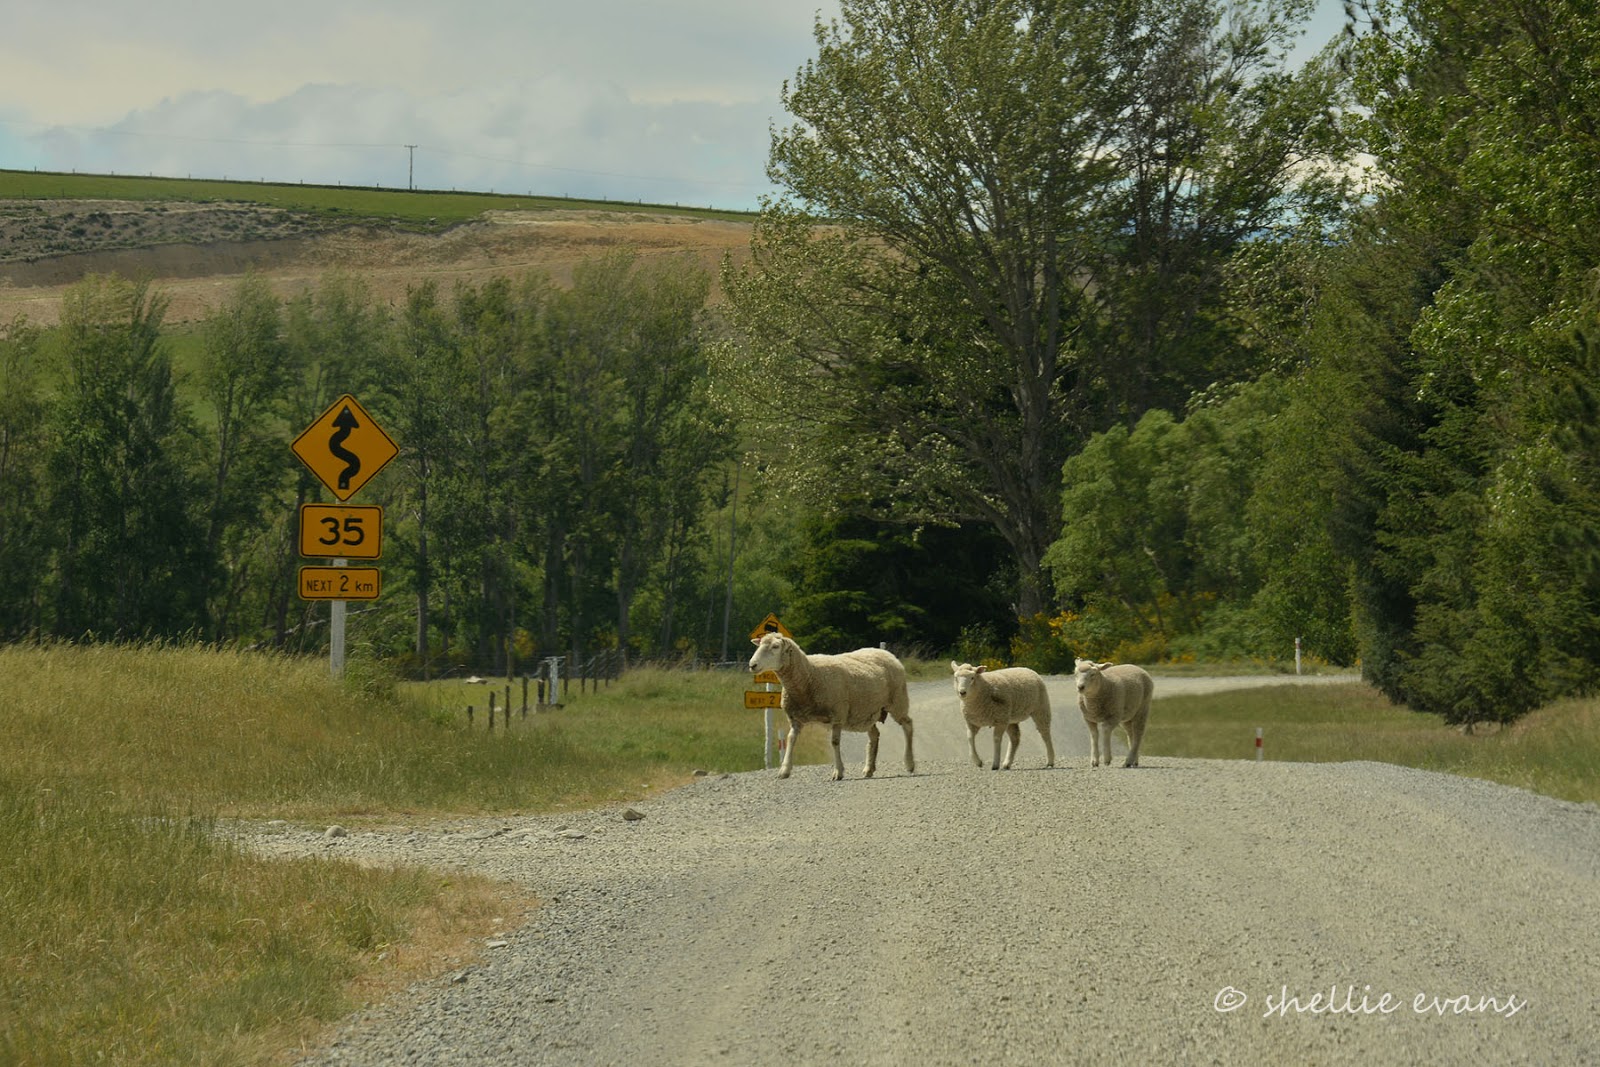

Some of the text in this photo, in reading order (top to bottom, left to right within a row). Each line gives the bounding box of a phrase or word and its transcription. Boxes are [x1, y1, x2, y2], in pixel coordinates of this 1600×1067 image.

[319, 516, 365, 546] 35
[306, 574, 374, 592] NEXT 2 km
[769, 695, 776, 705] 2
